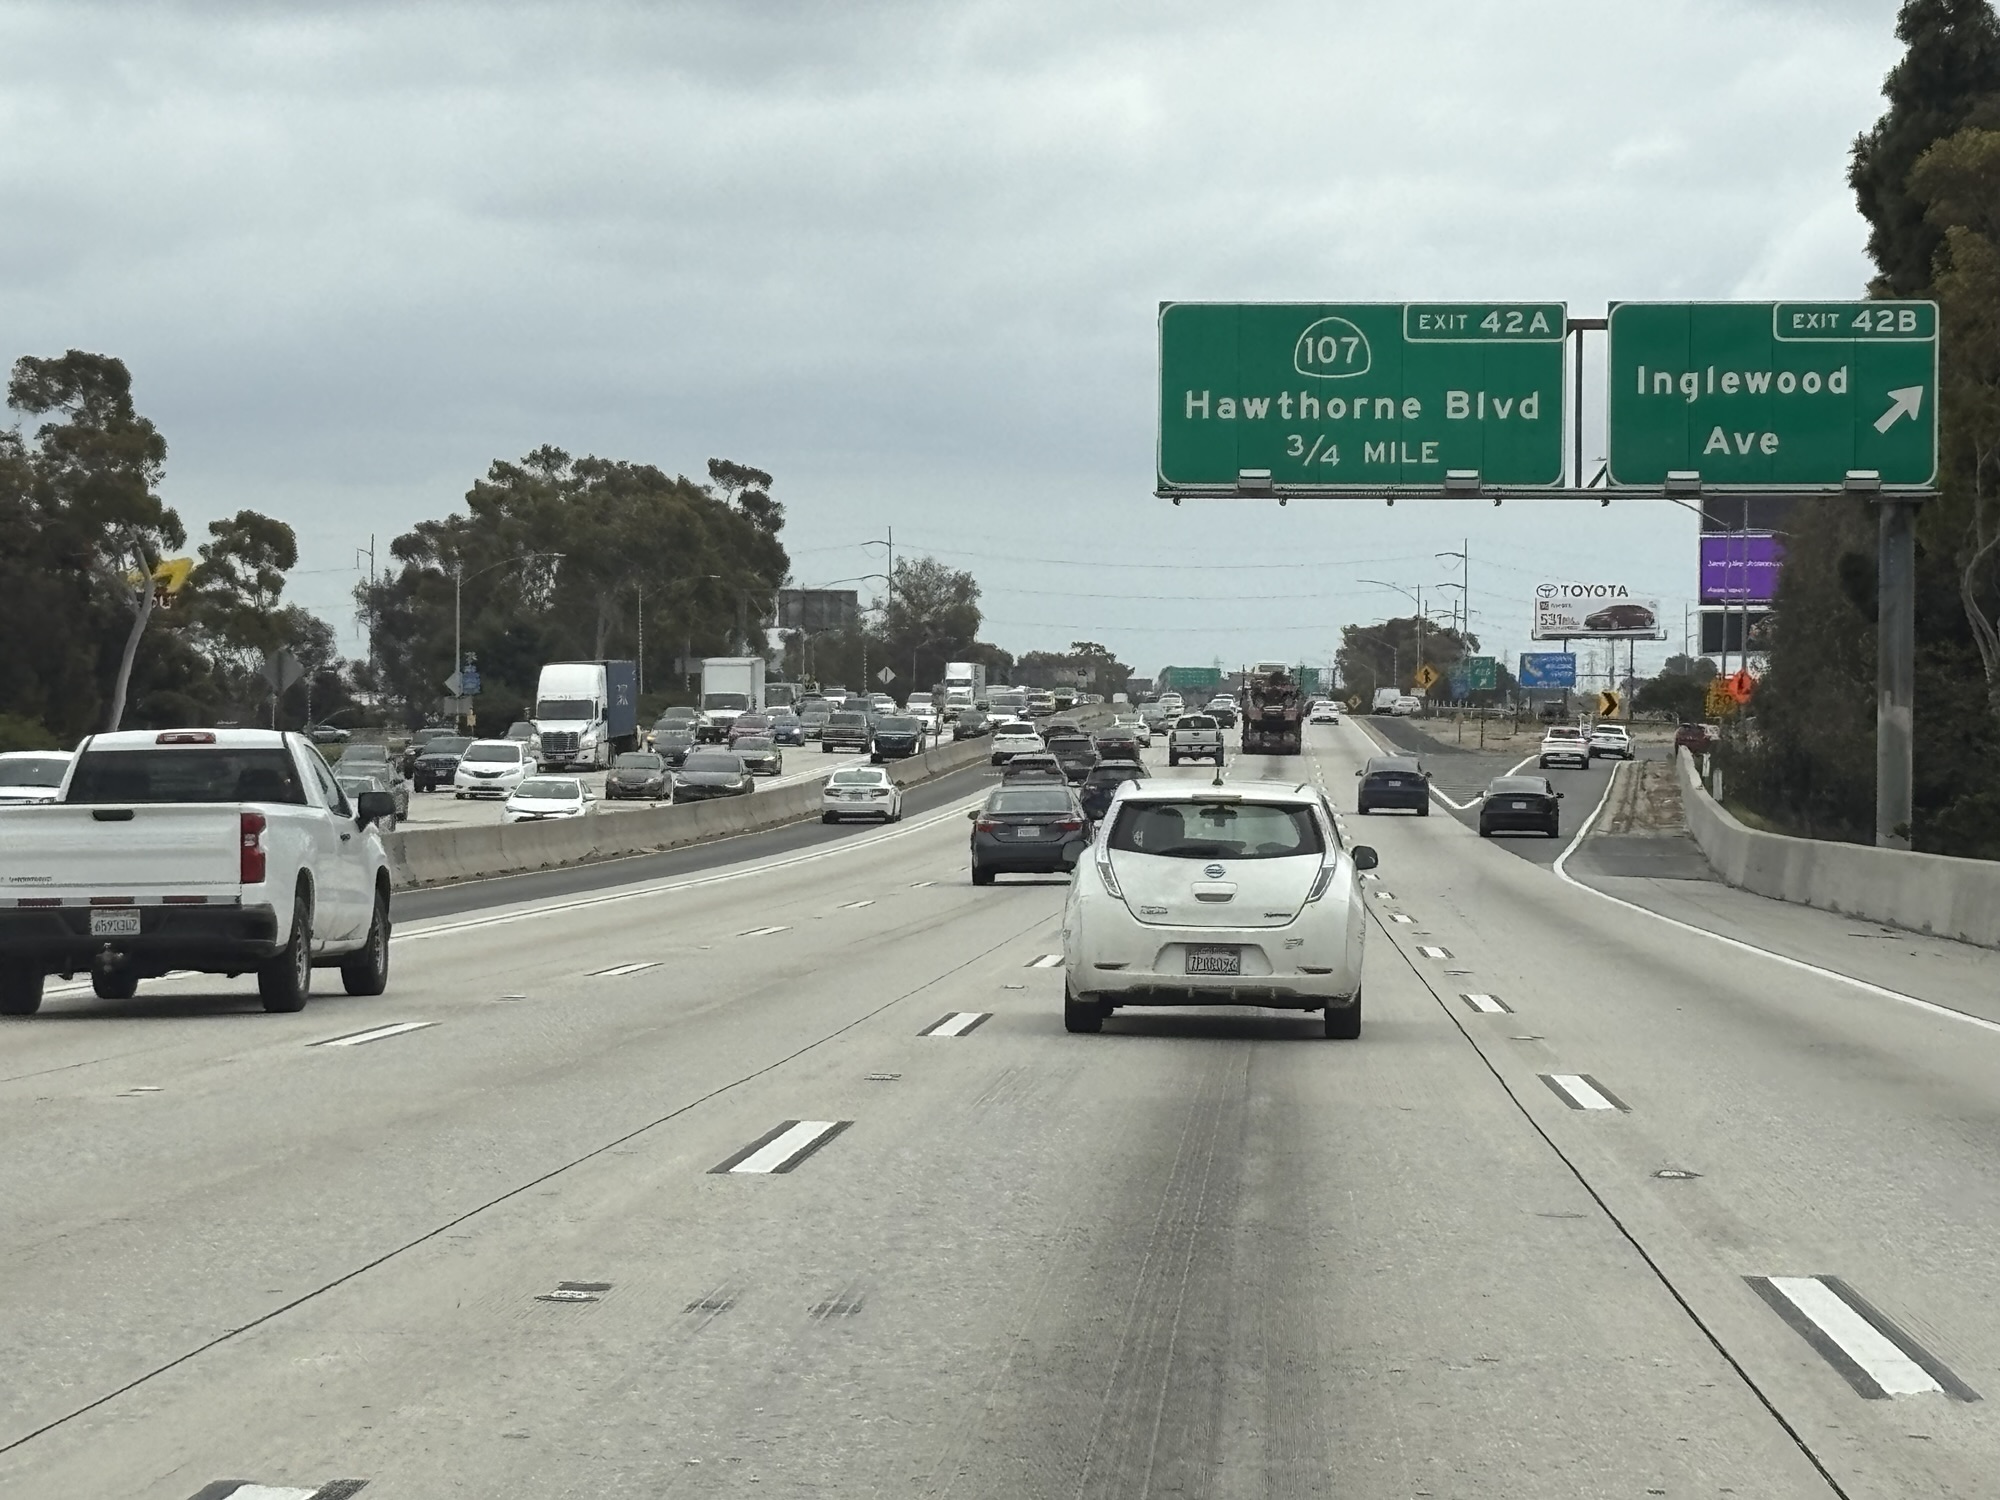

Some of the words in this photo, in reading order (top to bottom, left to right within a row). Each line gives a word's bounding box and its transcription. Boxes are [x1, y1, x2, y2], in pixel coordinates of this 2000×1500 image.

[1418, 314, 1467, 331] EXIT
[1479, 311, 1551, 334] 42A
[1793, 313, 1840, 329] EXIT
[1851, 309, 1917, 333] 42B
[1304, 337, 1360, 364] 107
[1637, 365, 1848, 404] Inglewood
[1185, 389, 1422, 420] Hawthorne
[1446, 389, 1540, 420] Blvd
[1286, 434, 1341, 467] 3/4
[1363, 441, 1440, 465] MILE
[1702, 425, 1780, 456] Ave
[1560, 584, 1629, 598] TOYOTA
